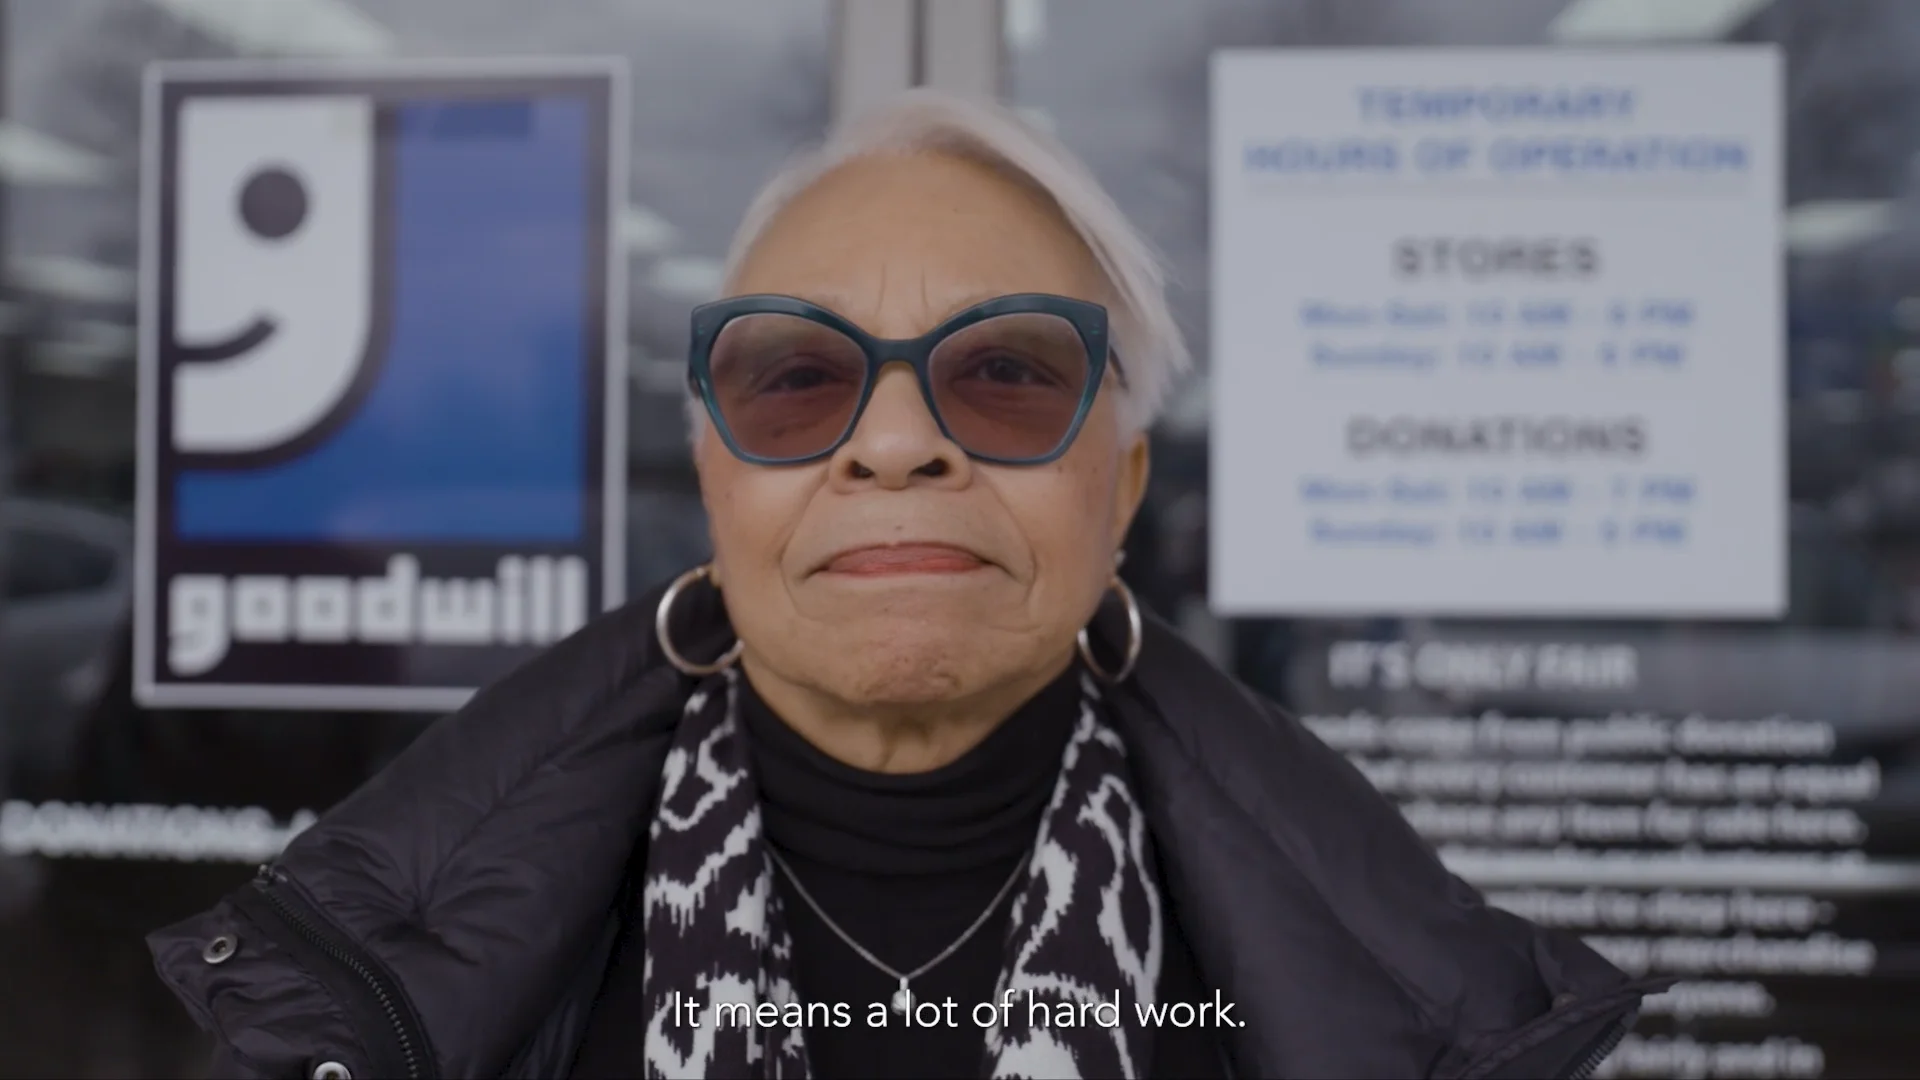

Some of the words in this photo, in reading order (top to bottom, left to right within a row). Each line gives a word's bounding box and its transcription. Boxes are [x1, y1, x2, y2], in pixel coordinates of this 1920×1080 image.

[1356, 85, 1637, 122] TEMPORARY
[1243, 136, 1400, 174] HOURS
[1412, 136, 1473, 174] OF
[1487, 136, 1750, 174] OPERATION
[1393, 237, 1602, 281] STORES
[1518, 299, 1575, 328] AM
[1639, 299, 1696, 328] PM
[1509, 341, 1565, 369] AM
[1629, 341, 1686, 370] PM
[1345, 413, 1649, 460] DONATIONS
[1519, 476, 1576, 504] AM
[1640, 476, 1697, 504] PM
[1509, 519, 1565, 547] AM
[1629, 519, 1687, 548] PM
[167, 553, 588, 676] goodwill
[1329, 642, 1410, 691] IT'S
[1414, 642, 1531, 692] ONLY
[1535, 642, 1638, 692] FAIR
